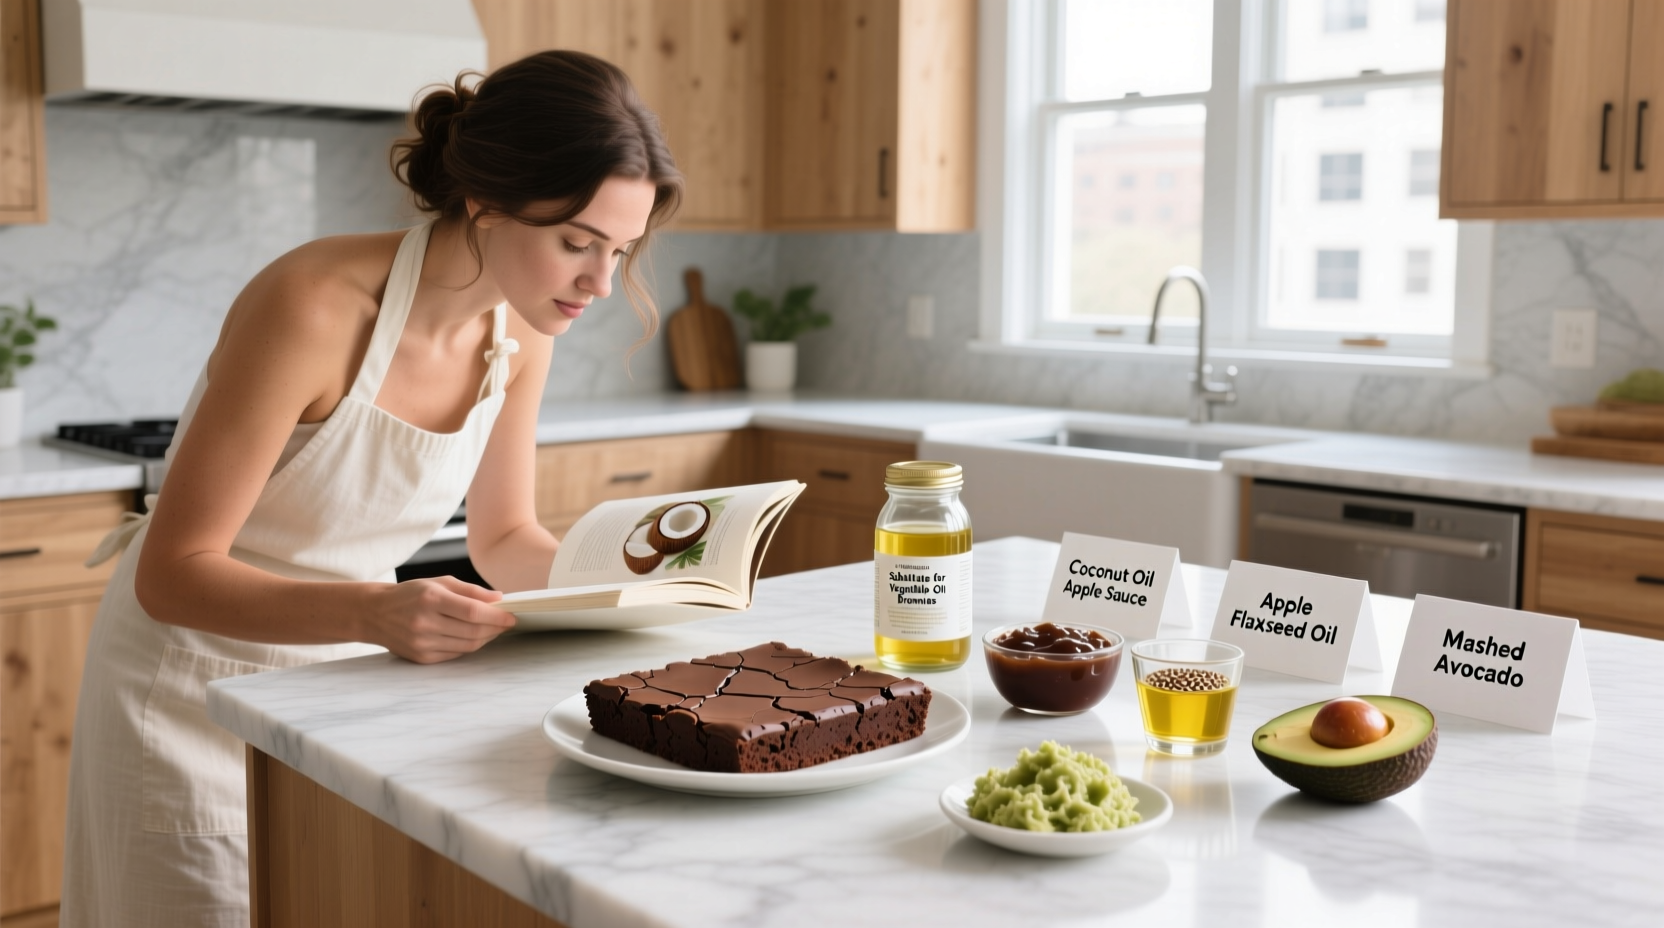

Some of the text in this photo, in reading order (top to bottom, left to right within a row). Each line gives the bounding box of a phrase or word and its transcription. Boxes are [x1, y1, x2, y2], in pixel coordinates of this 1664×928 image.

[1068, 558, 1156, 588] Coconut Oil
[1062, 578, 1148, 607] Apple Sauce
[1259, 592, 1313, 619] Apple
[1229, 609, 1338, 646] Flaxseed Oil
[1442, 628, 1527, 661] Mashed
[1433, 653, 1524, 688] Avocado
